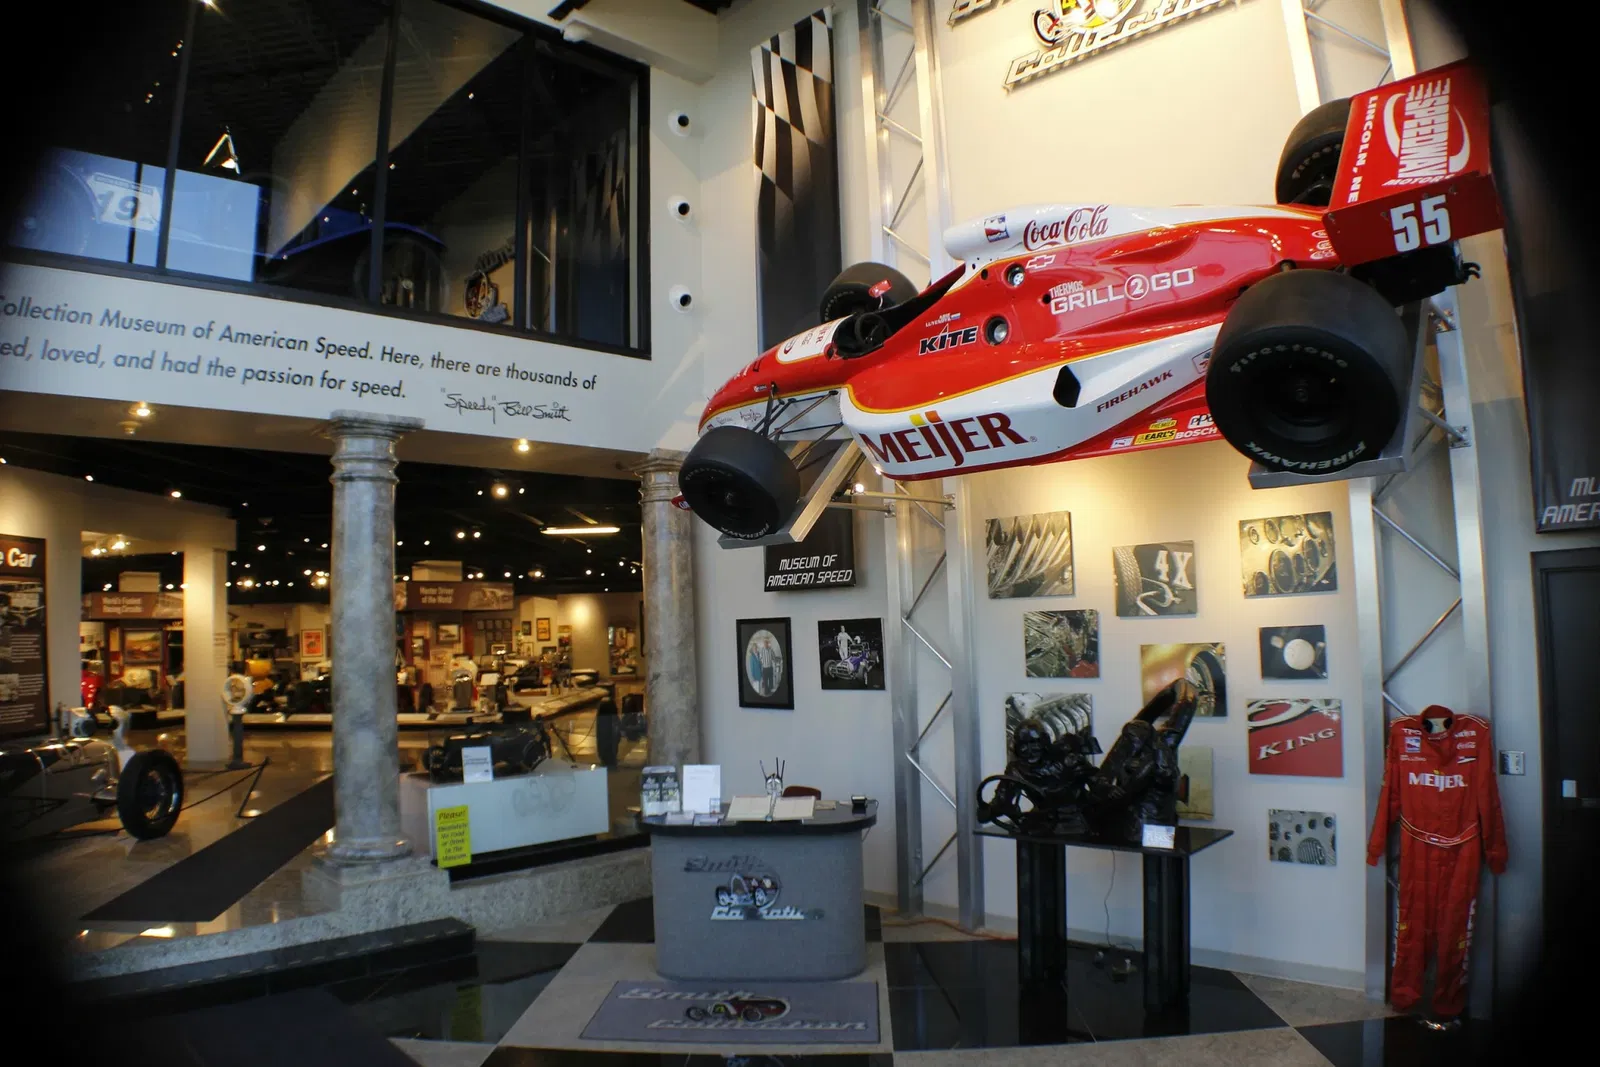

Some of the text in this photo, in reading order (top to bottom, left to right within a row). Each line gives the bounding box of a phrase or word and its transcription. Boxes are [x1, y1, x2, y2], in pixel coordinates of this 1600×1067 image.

[1348, 95, 1378, 203] LINCOLN, NE
[1398, 94, 1450, 179] SPEEDWAY
[1023, 204, 1111, 252] Coca-Cola
[1390, 194, 1451, 253] 55
[1049, 280, 1084, 298] THERMOS
[1050, 284, 1125, 315] GRILL
[1151, 268, 1195, 291] GO
[99, 308, 186, 336] Museum
[192, 320, 215, 340] of
[218, 325, 309, 351] American
[315, 336, 373, 360] Speed.
[380, 346, 424, 369] Here,
[430, 351, 471, 373] there
[475, 363, 501, 377] are
[506, 362, 578, 388] thousands
[582, 375, 597, 390] of
[919, 324, 978, 355] KITE
[0, 336, 406, 399] ed, loved, and had the passion for speed.
[1097, 369, 1174, 413] FIREHAWK
[498, 401, 532, 417] Bill
[532, 402, 572, 422] Smith
[859, 412, 1029, 467] MEIJER
[1144, 430, 1175, 441] EARL'S
[1175, 427, 1218, 440] BOSCH
[1245, 441, 1367, 470] FIREHAWK
[7, 547, 37, 568] Car
[779, 554, 838, 571] MUSEUM OF
[766, 569, 853, 587] AMERICAN SPEED
[1256, 728, 1336, 761] KING
[1408, 772, 1465, 792] MEIJER
